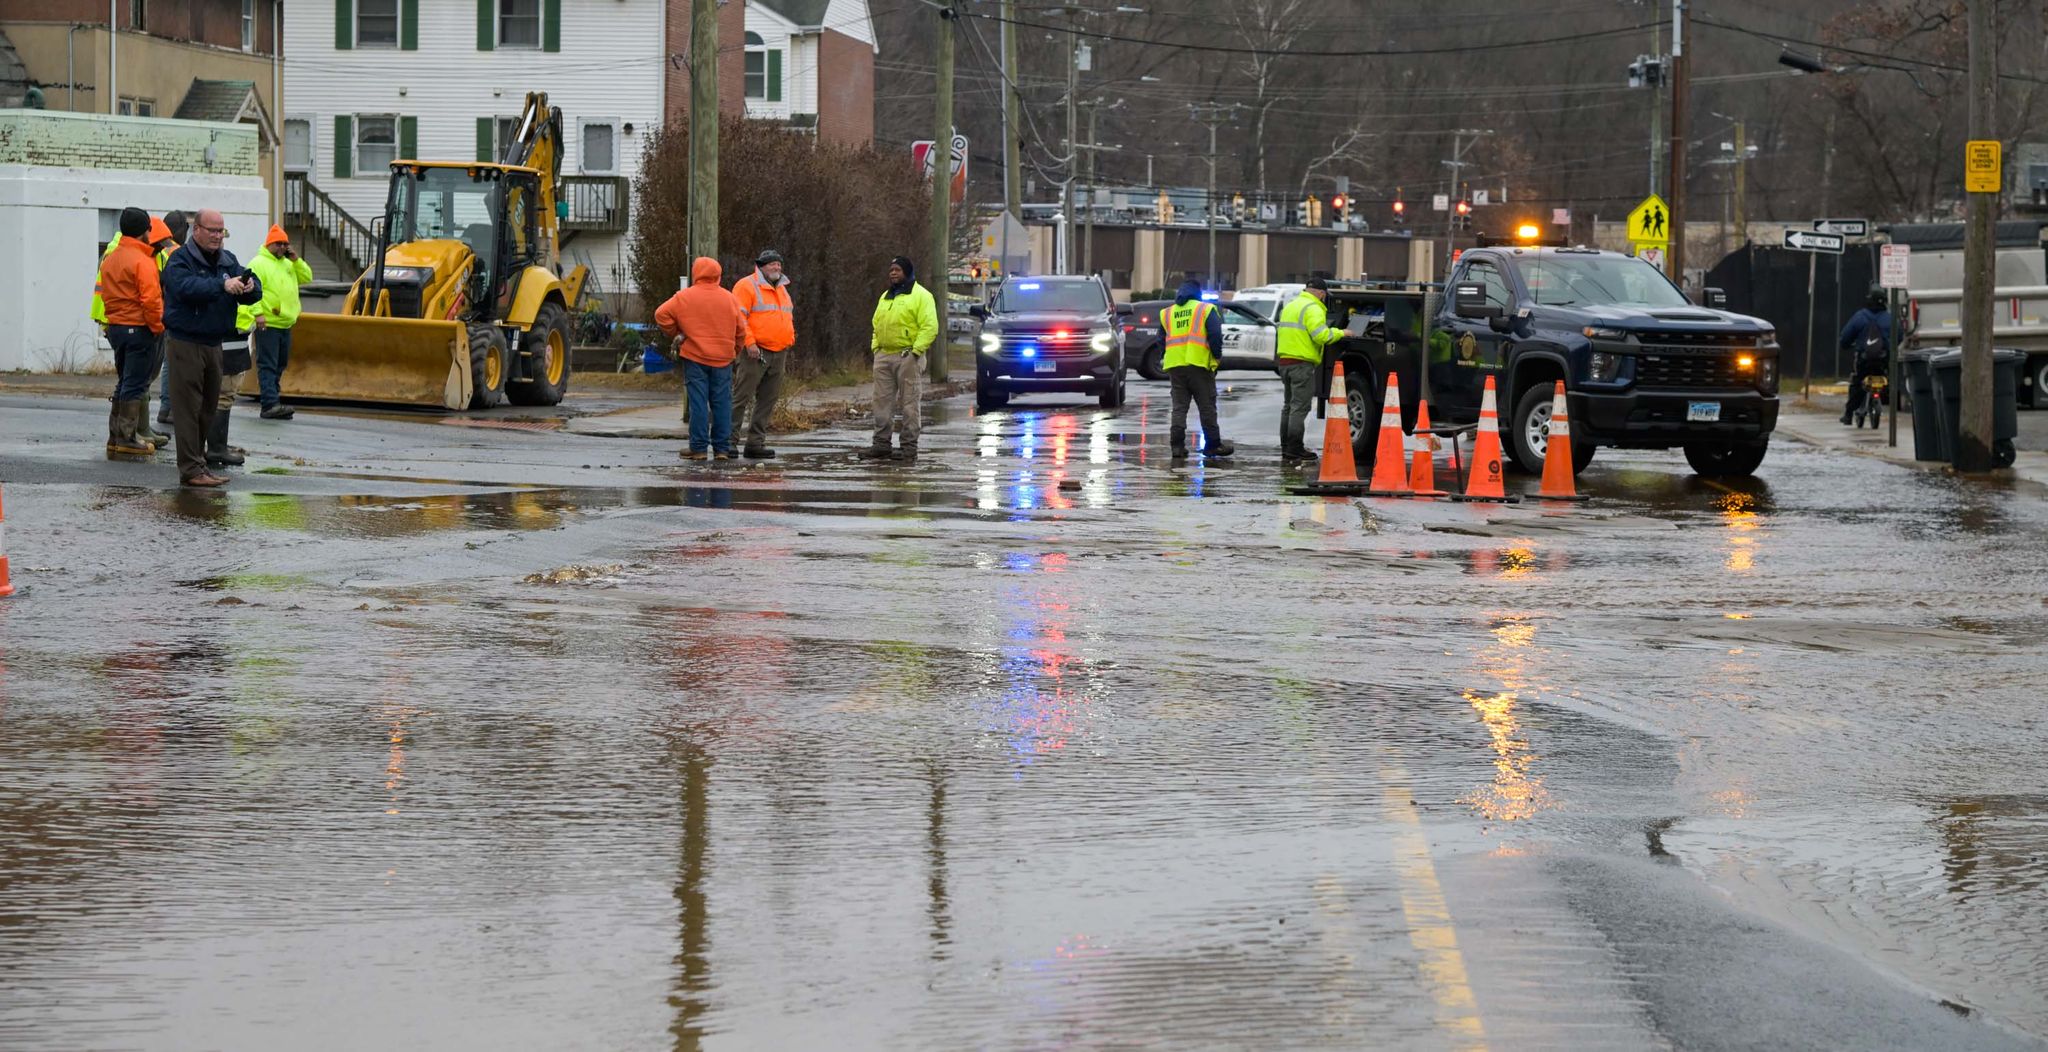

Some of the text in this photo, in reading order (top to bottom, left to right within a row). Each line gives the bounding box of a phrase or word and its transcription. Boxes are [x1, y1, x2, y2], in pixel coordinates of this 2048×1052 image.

[515, 194, 525, 225] CAT
[1829, 225, 1843, 233] ONE
[1802, 236, 1837, 247] ONE WAY
[1174, 309, 1192, 319] WATER
